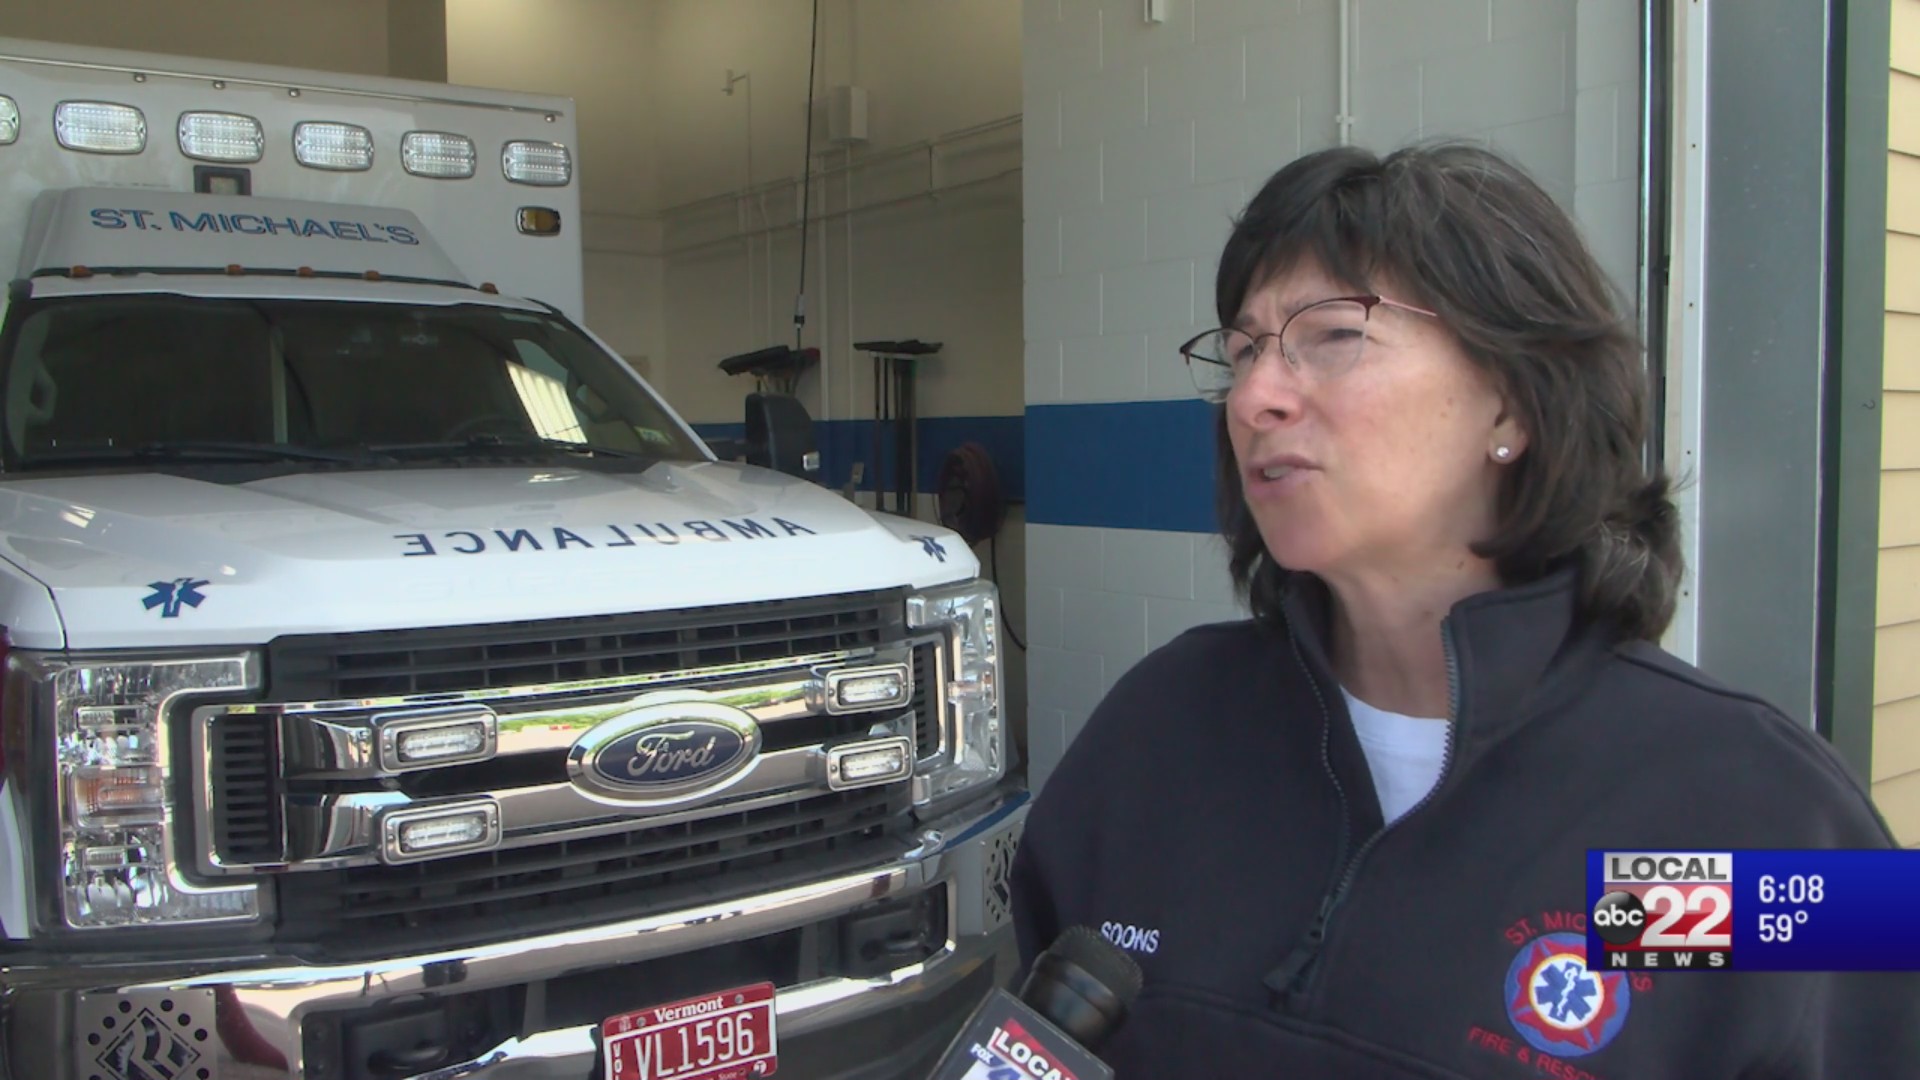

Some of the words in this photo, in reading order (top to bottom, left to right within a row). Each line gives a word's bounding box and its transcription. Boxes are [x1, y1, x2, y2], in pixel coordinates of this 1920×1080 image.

[90, 208, 161, 231] ST.
[168, 211, 420, 246] MICHAEL'S
[627, 730, 717, 777] Ford
[1101, 920, 1160, 953] SOONS
[1505, 917, 1537, 946] ST.
[654, 996, 724, 1023] Vermont
[634, 1011, 754, 1080] VL1596
[970, 1042, 994, 1064] FOX
[996, 1030, 1072, 1080] LOCA
[1468, 1026, 1514, 1058] FIRE
[1517, 1046, 1531, 1064] &
